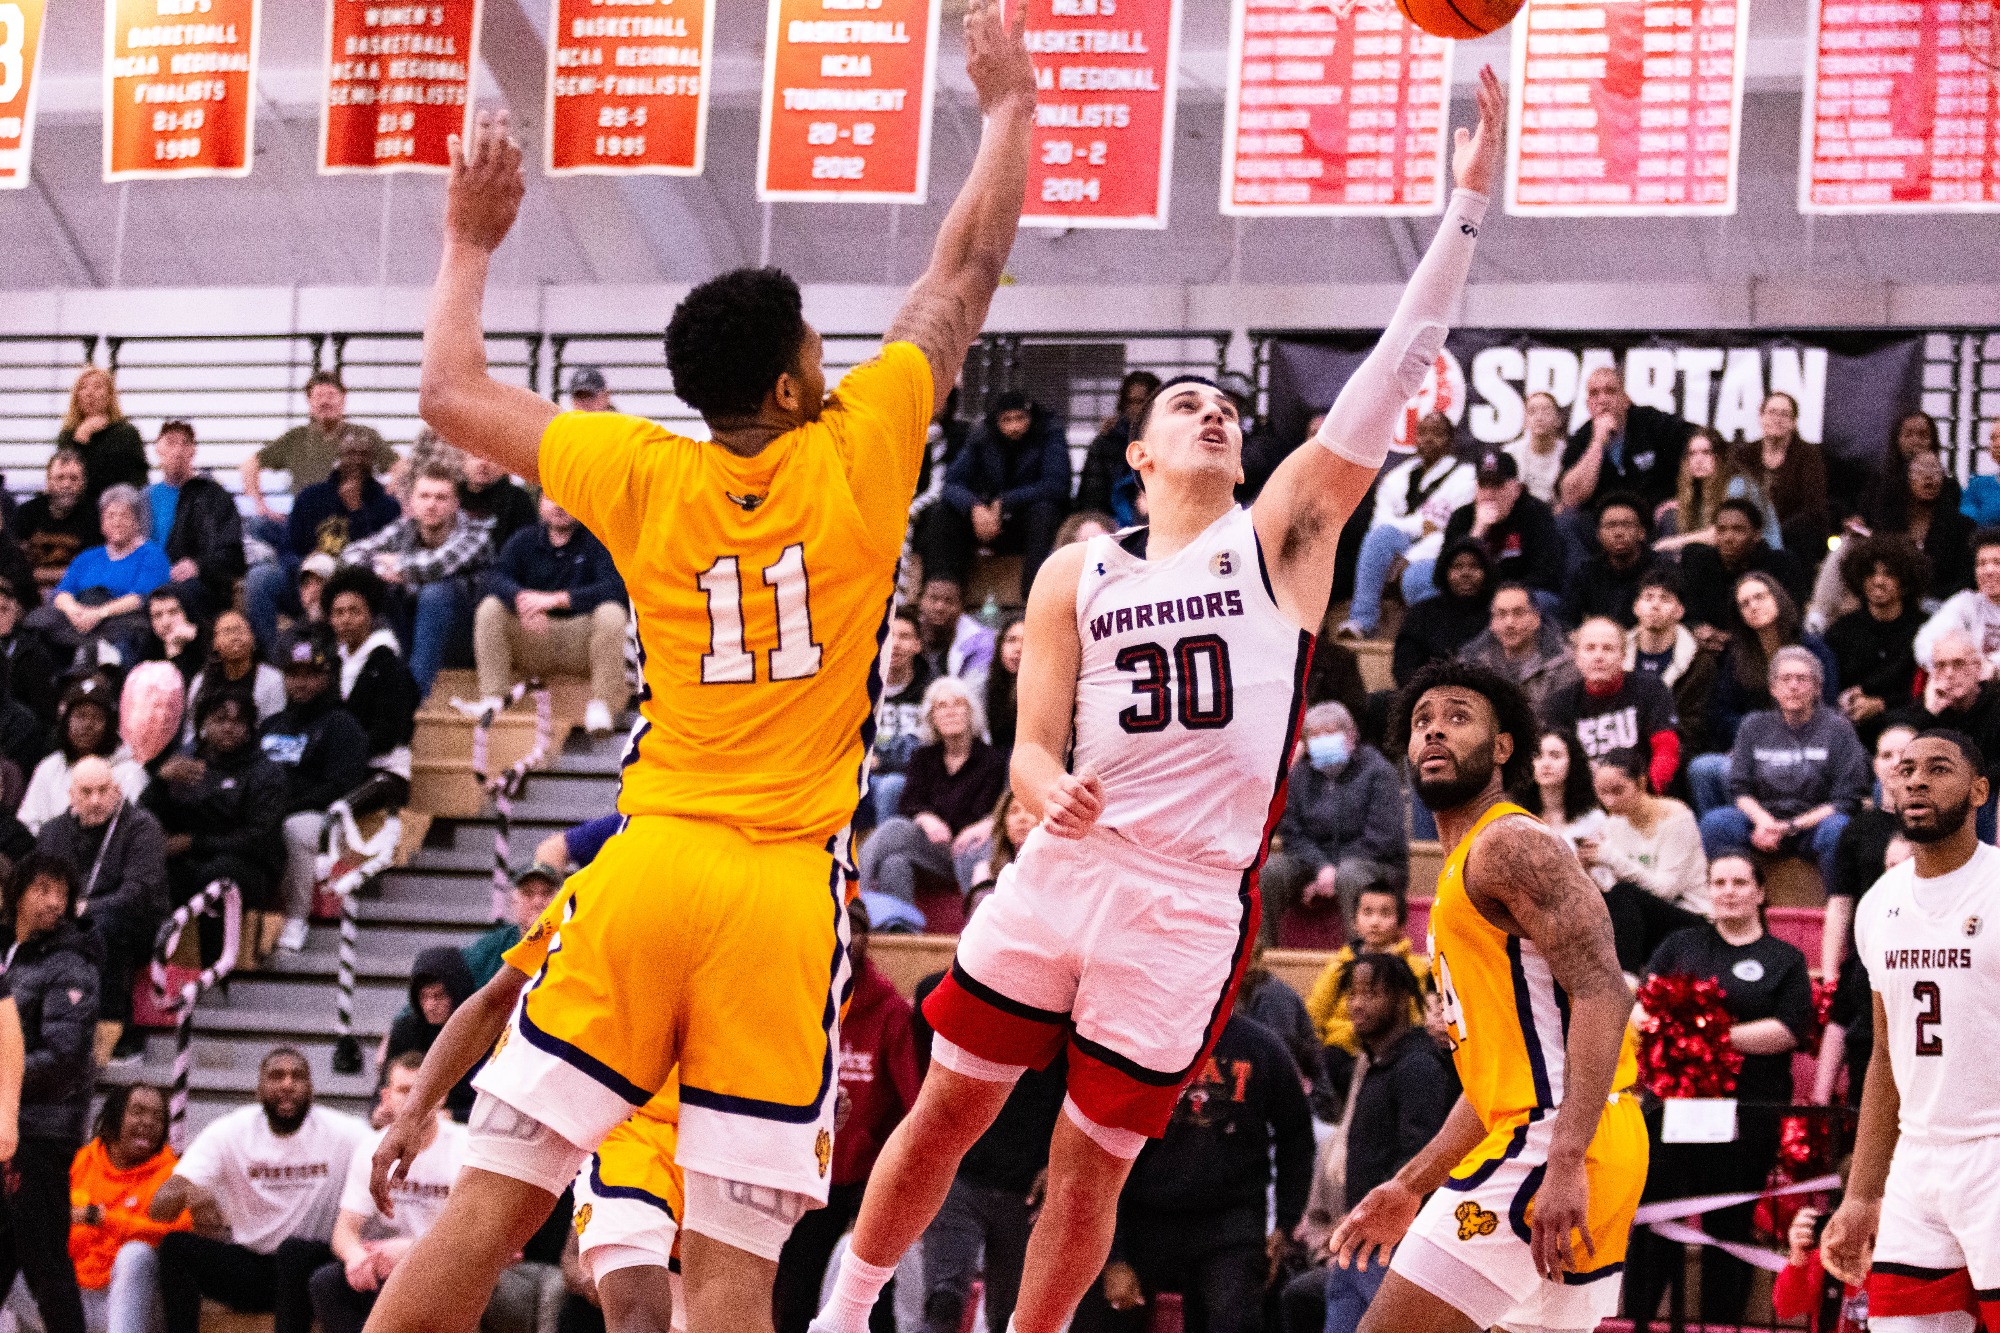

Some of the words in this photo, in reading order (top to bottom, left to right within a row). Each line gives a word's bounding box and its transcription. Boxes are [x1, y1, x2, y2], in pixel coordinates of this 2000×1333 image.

[157, 0, 212, 15] MENS
[365, 6, 444, 26] WOMEN'S
[1051, 0, 1117, 16] MENS
[127, 23, 238, 49] BASKETBALL
[573, 17, 687, 38] BASKETBALL
[788, 20, 910, 43] BASKETBALL
[345, 35, 456, 55] BASKETBALL
[556, 47, 603, 67] NCAA
[615, 46, 701, 67] REGIONAL
[113, 56, 159, 77] NCAA
[171, 52, 249, 74] REGIONAL
[332, 62, 380, 80] NCAA
[388, 60, 466, 80] REGIONAL
[821, 54, 871, 77] NCAA
[555, 75, 700, 96] SEMI-FINALISTS
[1059, 66, 1161, 91] REGIONAL
[134, 80, 225, 104] FINALISTS
[783, 87, 907, 112] TOURNAMENT
[1032, 104, 1131, 128] INALISTS
[811, 155, 866, 180] 2012
[1041, 177, 1100, 203] 2014
[696, 541, 823, 684] 11
[1090, 589, 1244, 642] WARRIORS
[1115, 633, 1233, 734] 30
[1885, 948, 1971, 970] WARRIORS
[1913, 981, 1943, 1058] 2
